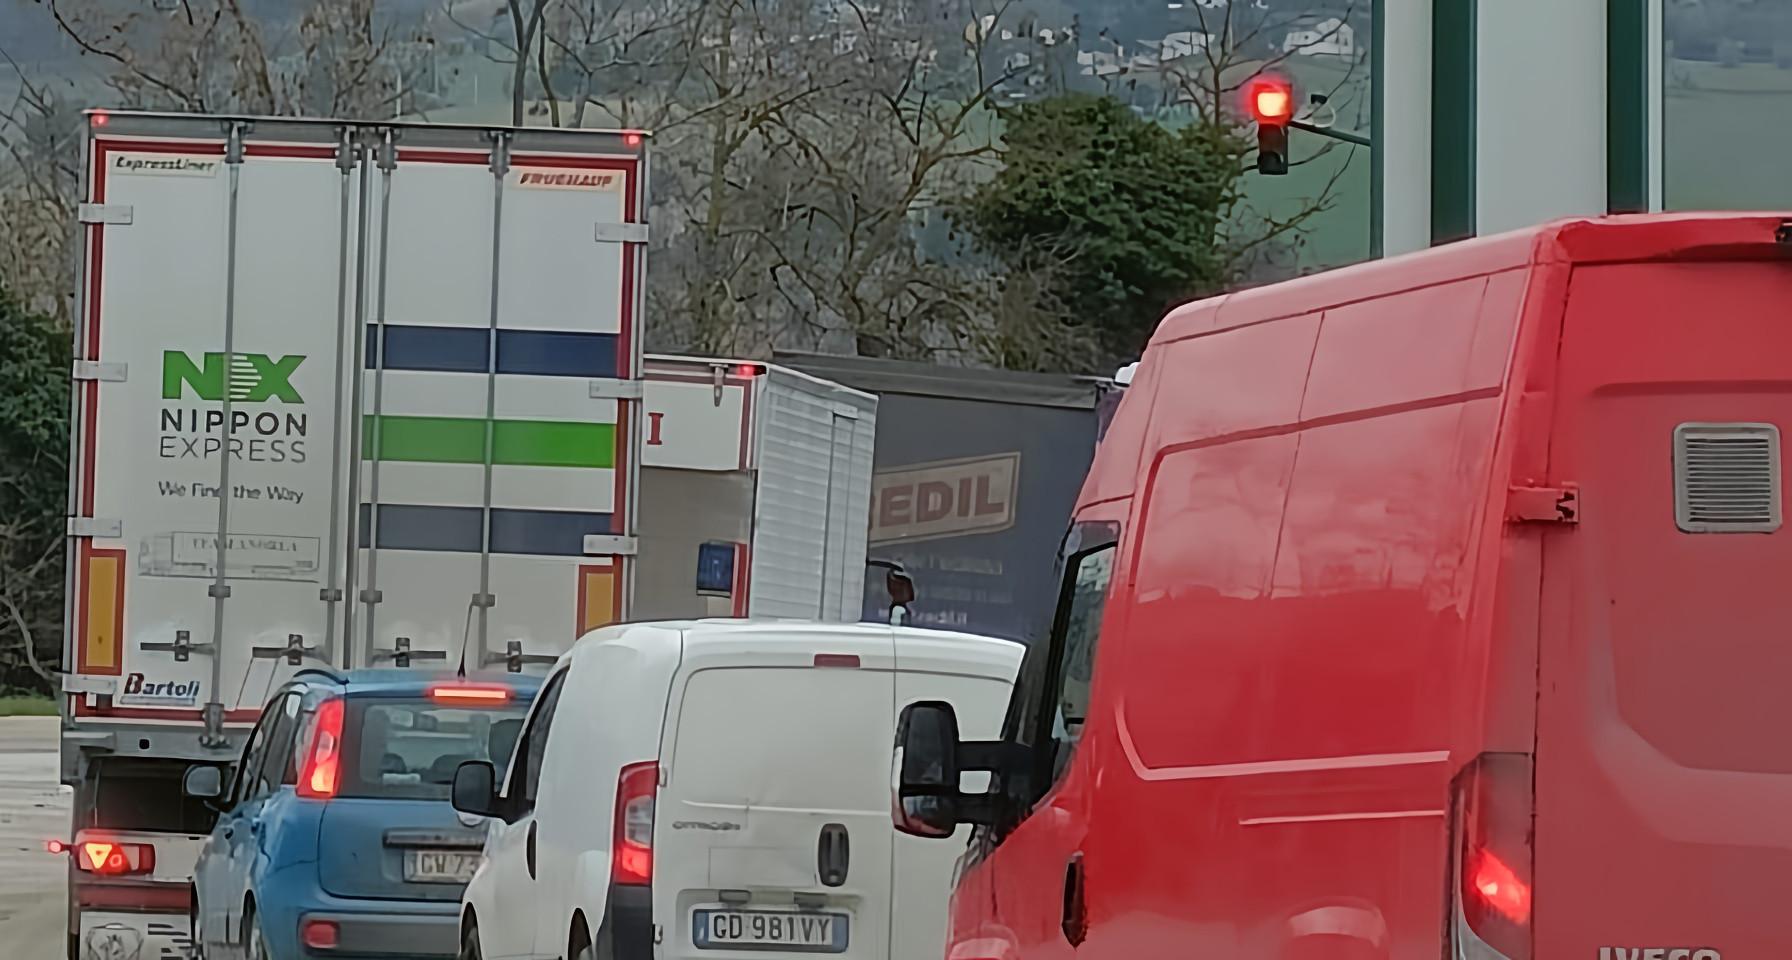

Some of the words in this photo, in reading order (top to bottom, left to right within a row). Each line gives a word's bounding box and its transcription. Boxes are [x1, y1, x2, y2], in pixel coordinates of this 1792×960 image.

[160, 408, 307, 437] NIPPON
[159, 436, 306, 463] EXPRESS
[158, 480, 187, 497] We
[233, 485, 262, 499] the
[266, 486, 304, 505] Way
[868, 473, 1005, 533] EDIL
[124, 672, 201, 697] Bartoli
[713, 914, 743, 939] GD
[752, 916, 830, 942] 981VY
